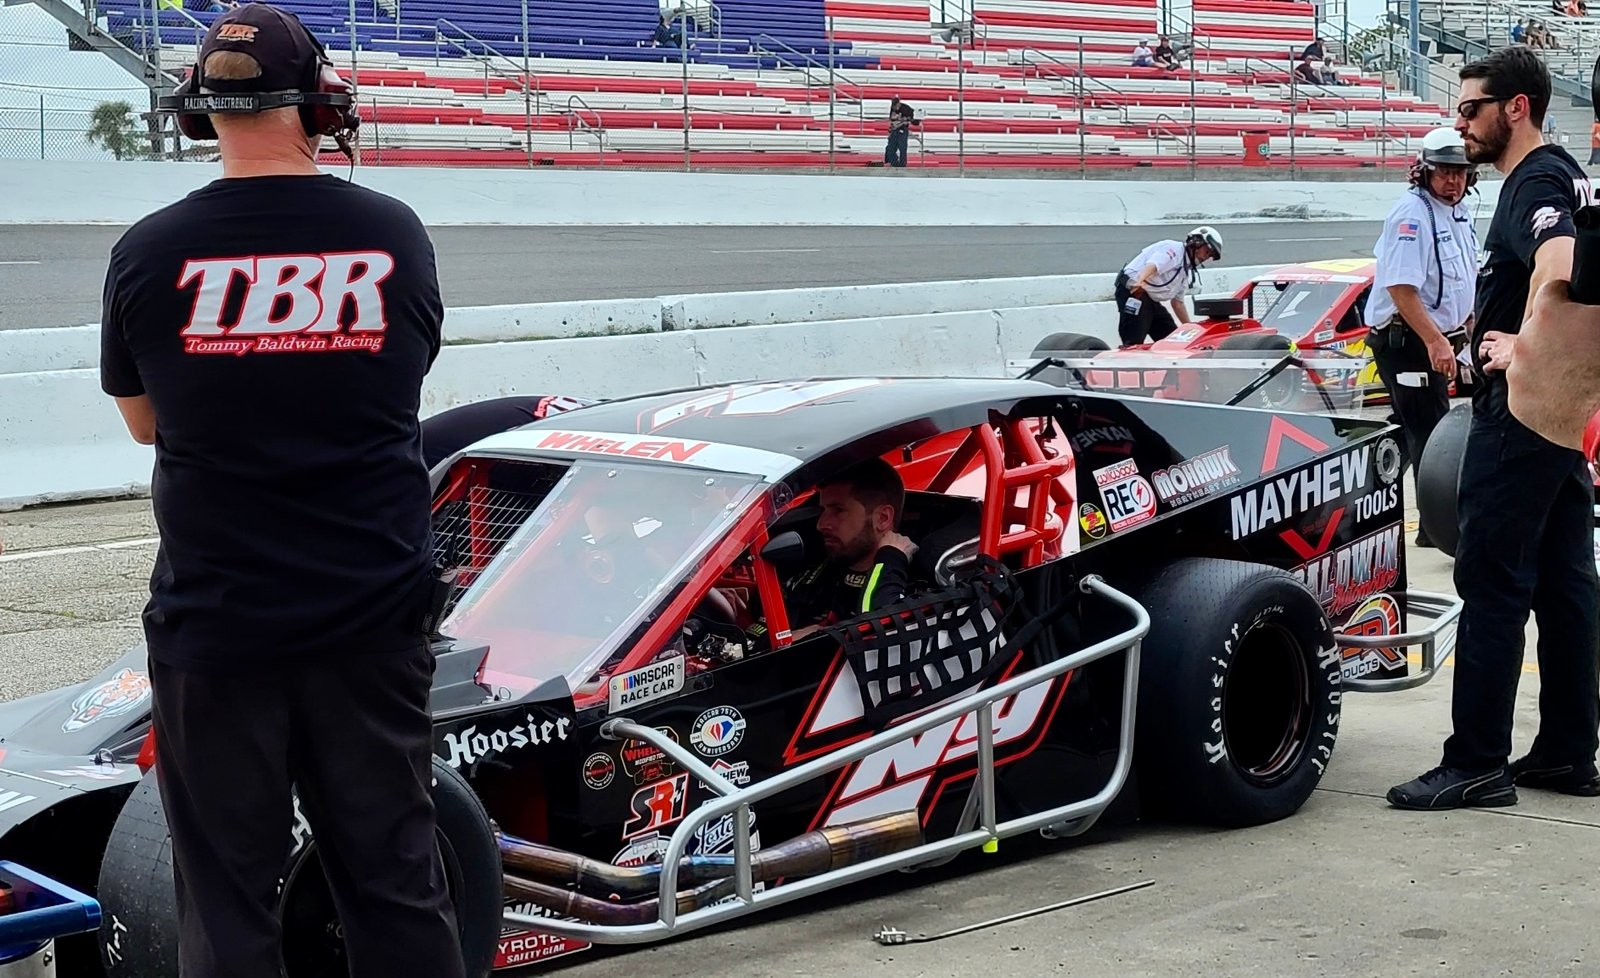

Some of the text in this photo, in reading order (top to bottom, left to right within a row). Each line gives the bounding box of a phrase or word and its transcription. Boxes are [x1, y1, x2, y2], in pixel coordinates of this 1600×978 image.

[184, 97, 253, 110] RACING ELECTRONICS
[177, 250, 394, 337] TBR
[185, 334, 383, 355] Tommy Baldwin Racing
[537, 431, 710, 462] WHELEN
[1154, 449, 1237, 500] MOHAWK
[1230, 445, 1370, 541] MAYHEW
[1355, 484, 1398, 523] TOOLS
[1296, 524, 1400, 603] ALDWIN
[633, 662, 675, 688] NASCAR
[1343, 659, 1379, 679] DUCTS
[620, 679, 675, 705] RACE CAR
[696, 707, 737, 729] NASCAR 75TH
[443, 712, 571, 769] Hoosier
[697, 731, 742, 755] ANNIVERSARY
[624, 746, 660, 762] WHEL
[498, 933, 567, 955] YROTE
[506, 943, 566, 964] SAFETY GEAR
